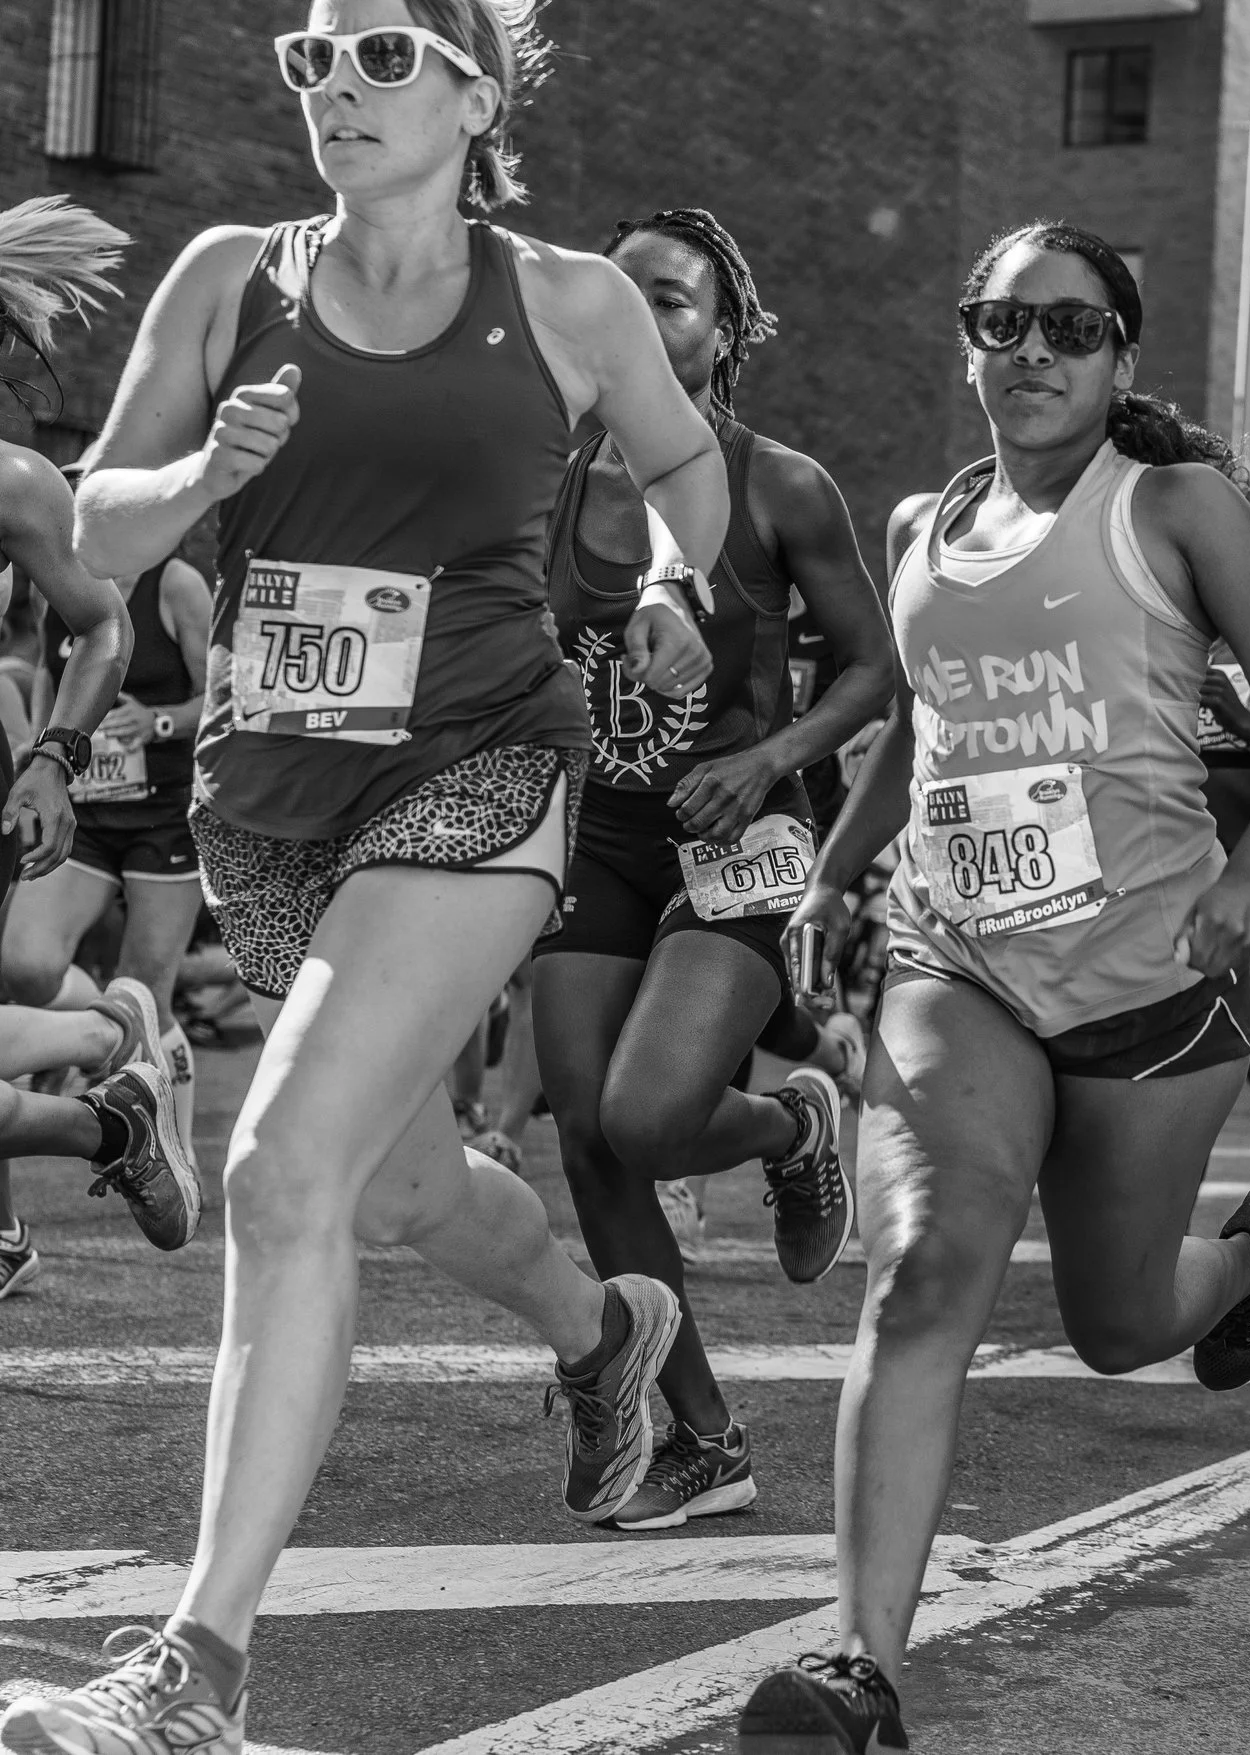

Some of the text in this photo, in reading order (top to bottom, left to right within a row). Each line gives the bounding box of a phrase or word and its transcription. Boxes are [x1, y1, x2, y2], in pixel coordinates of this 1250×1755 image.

[246, 588, 293, 604] MILE
[260, 621, 367, 697] 750
[979, 640, 1085, 701] RUN
[306, 710, 348, 729] BEV
[609, 660, 654, 738] B
[928, 790, 965, 805] BKLYN
[929, 804, 967, 821] MILE
[698, 844, 739, 862] MILE
[721, 846, 806, 893] 615
[949, 825, 1056, 900] 848
[977, 889, 1088, 937] #RunBrooklyn
